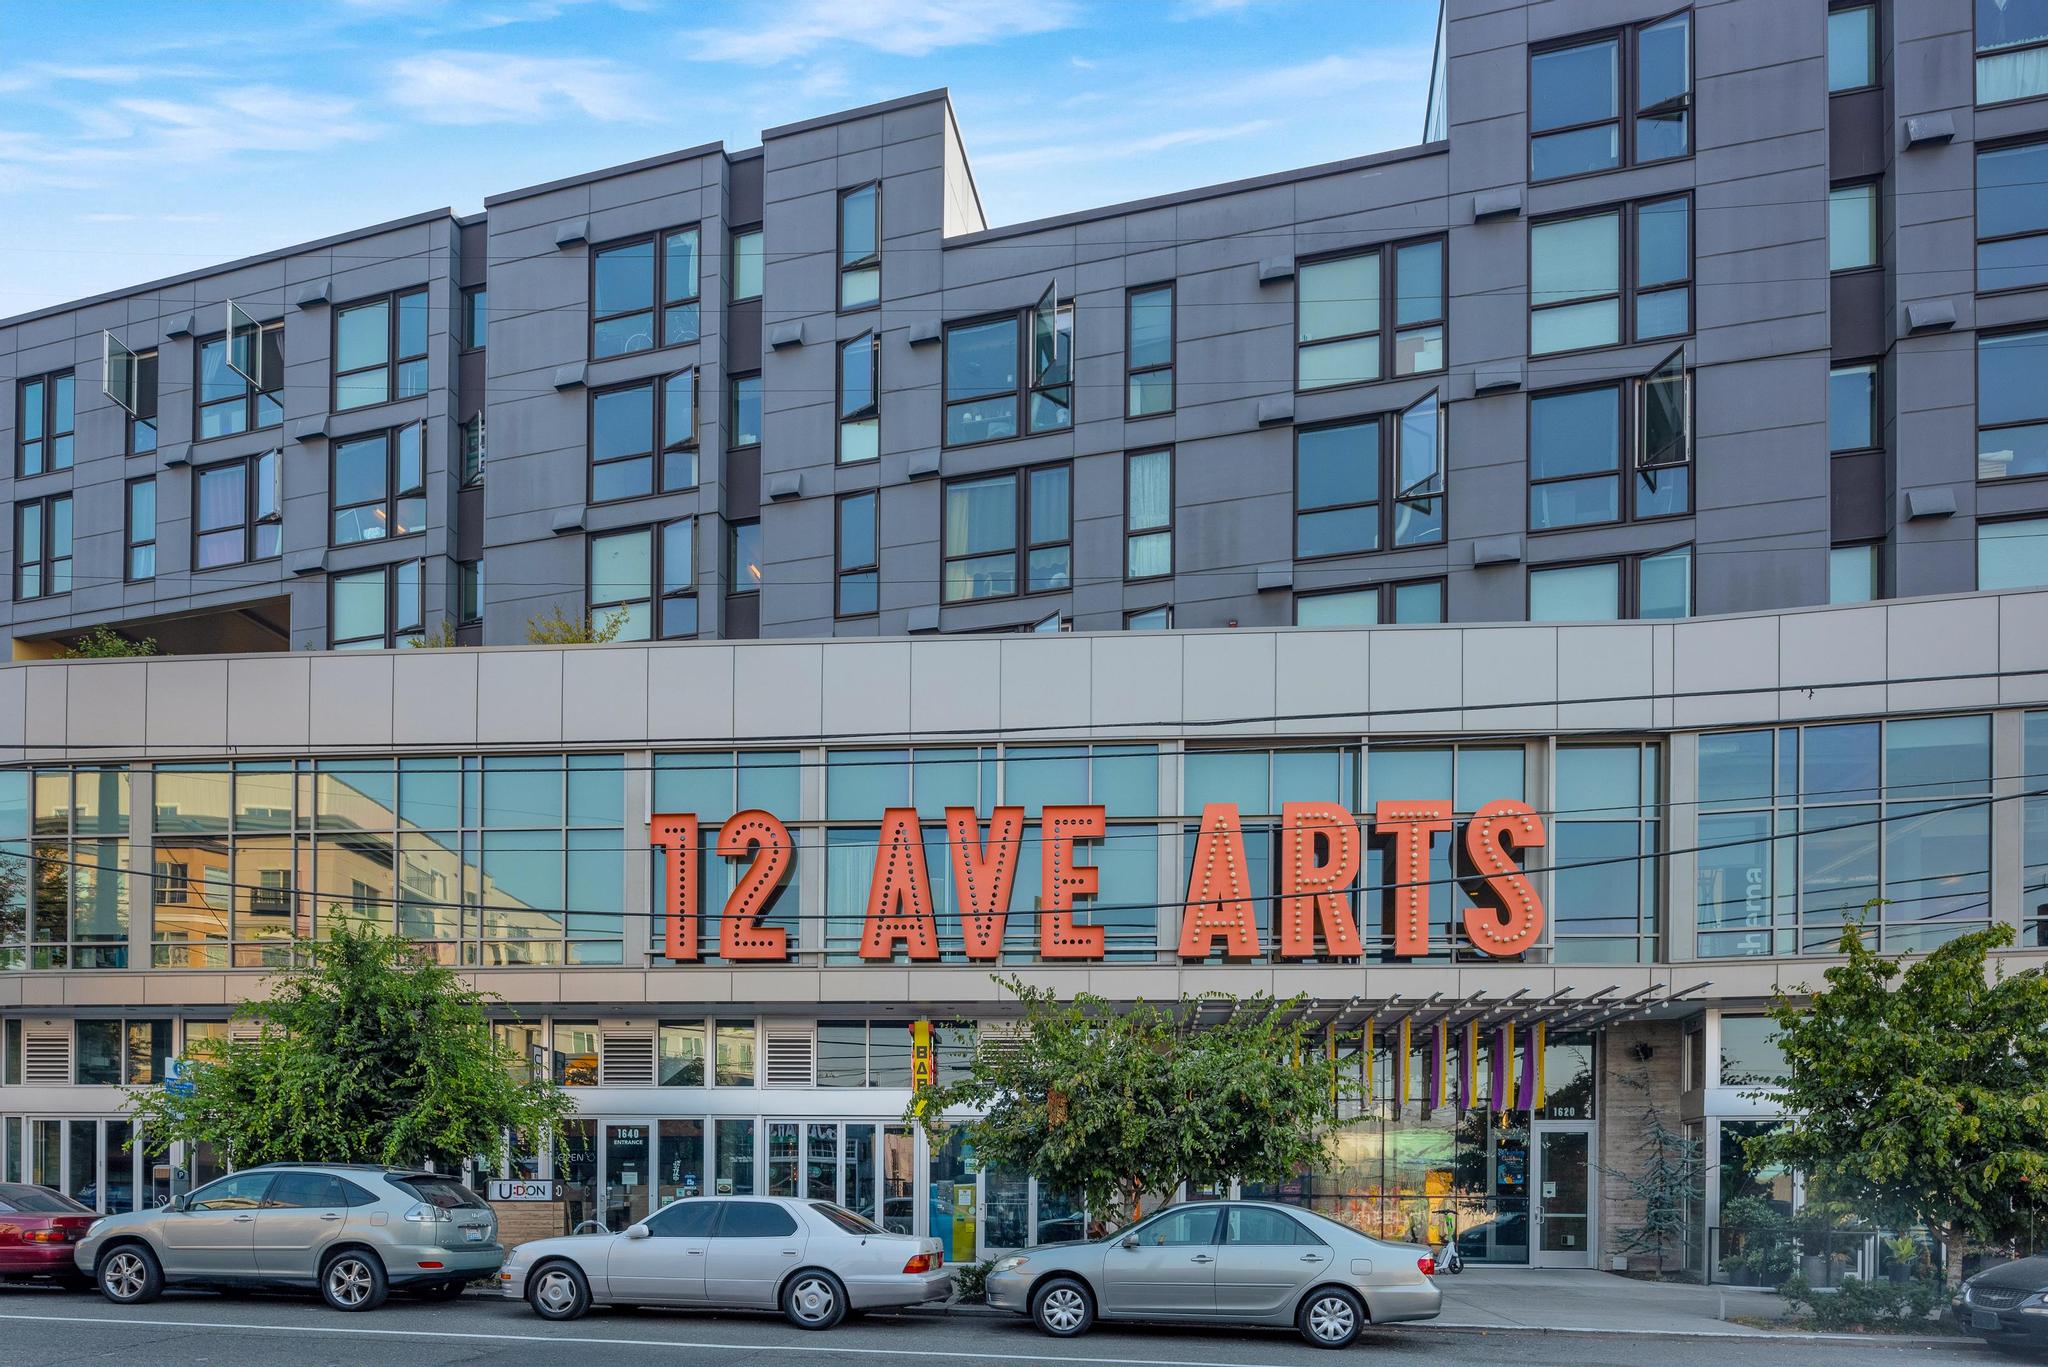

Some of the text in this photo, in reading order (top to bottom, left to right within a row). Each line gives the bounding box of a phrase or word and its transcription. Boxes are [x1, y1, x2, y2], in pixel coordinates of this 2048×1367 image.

[651, 799, 1545, 959] 12 AVE ARTS
[1553, 1107, 1575, 1117] 1620
[617, 1129, 639, 1139] 1640
[557, 1153, 584, 1162] OEN
